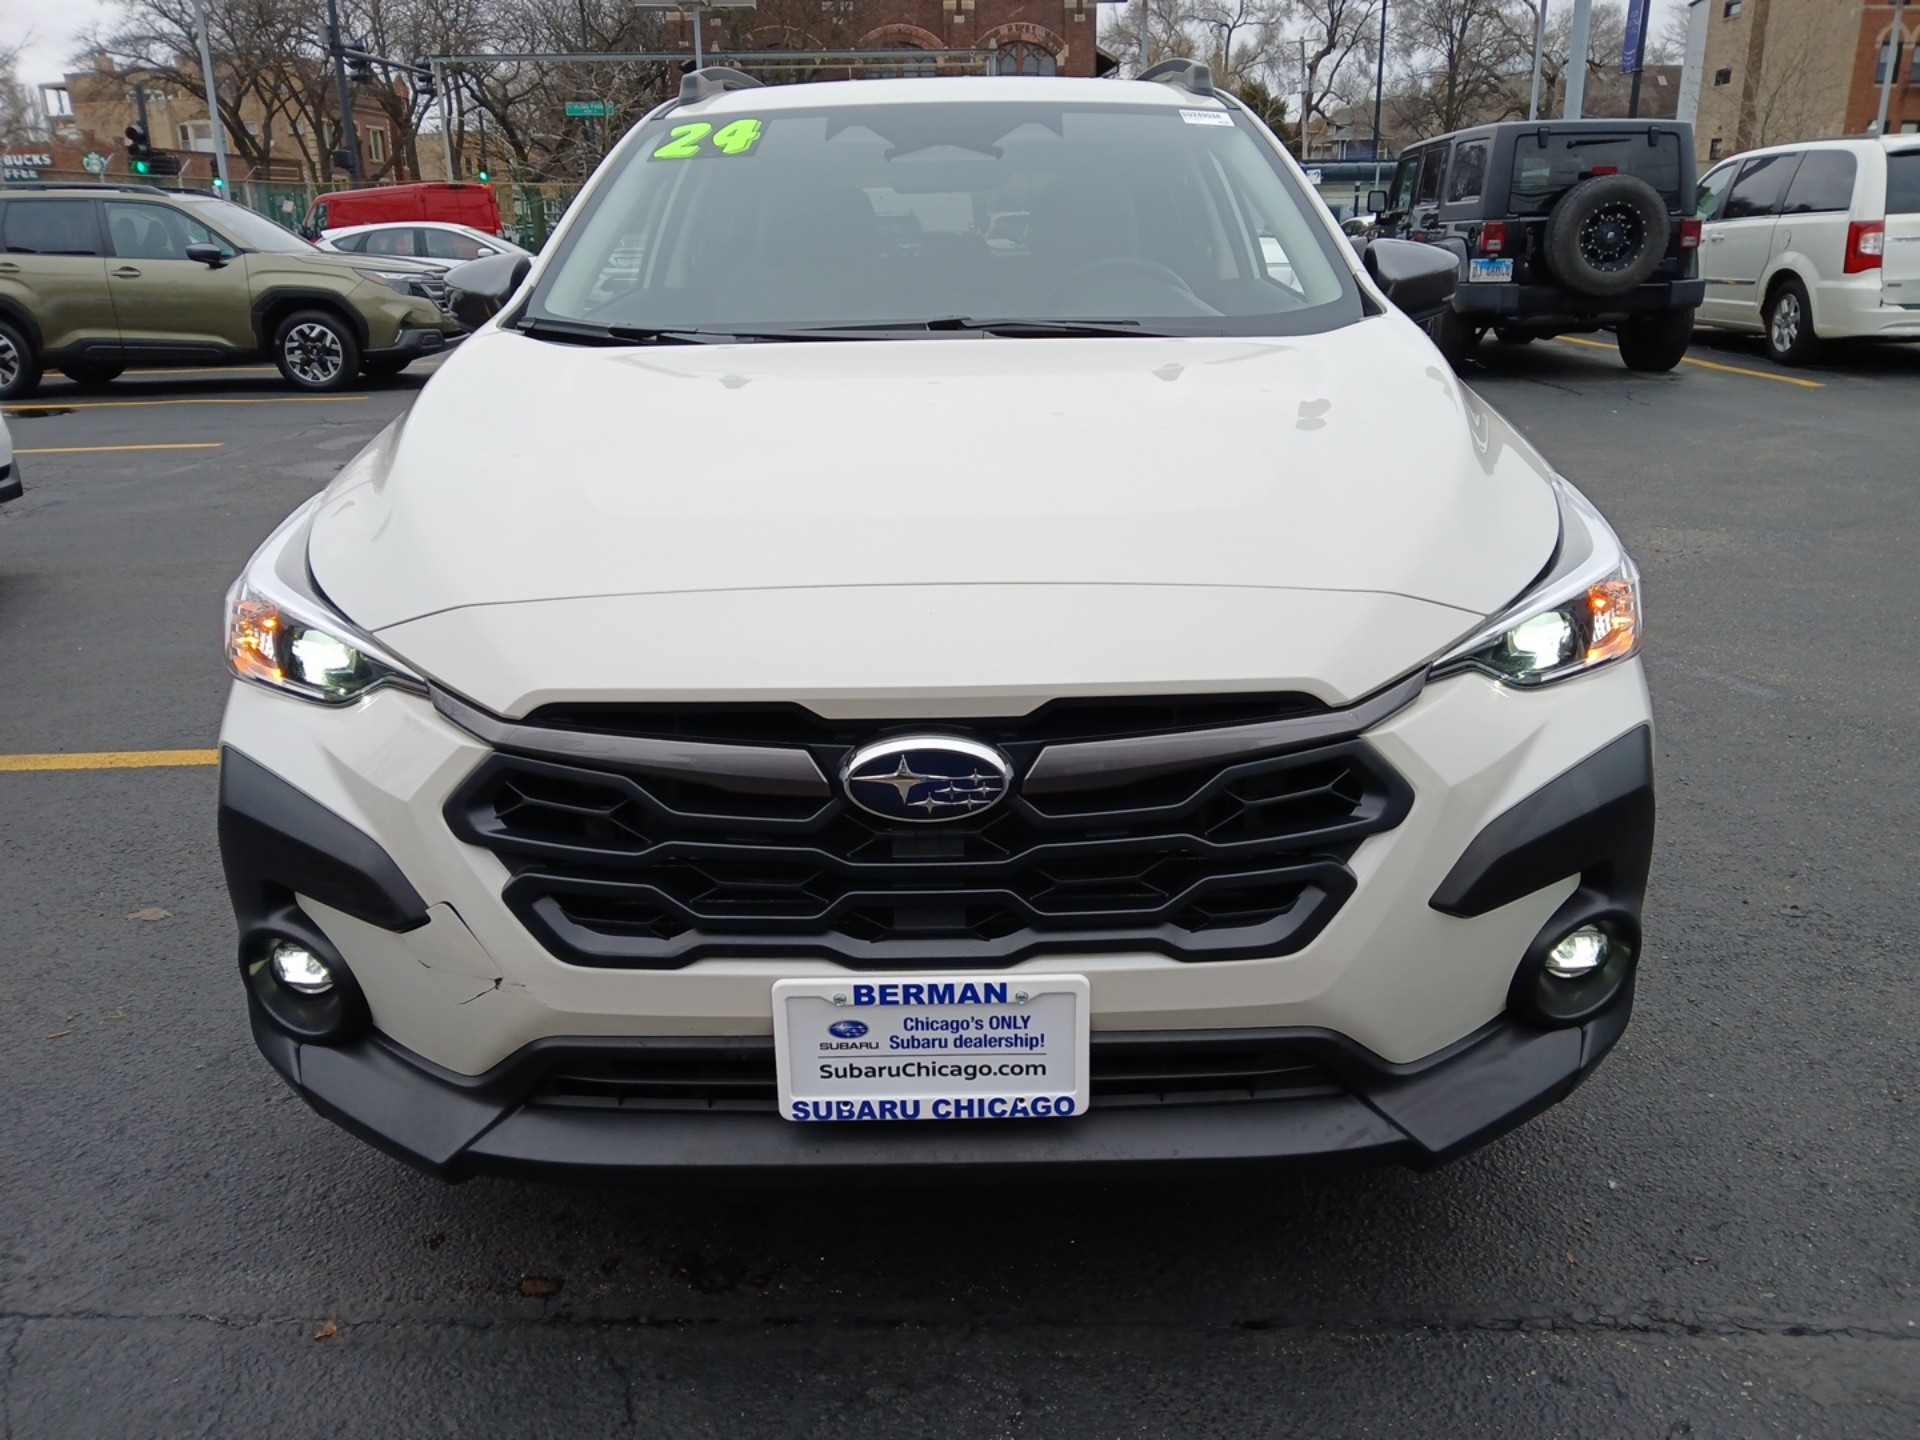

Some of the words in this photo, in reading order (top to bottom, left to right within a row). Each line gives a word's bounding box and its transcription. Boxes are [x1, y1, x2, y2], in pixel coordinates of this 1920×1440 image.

[653, 119, 762, 159] 24
[852, 982, 1008, 1006] BERMAN
[903, 1016, 984, 1033] Chicago's
[989, 1015, 1031, 1031] ONLY
[819, 1042, 879, 1050] SUBARU
[889, 1035, 948, 1050] Subaru
[953, 1033, 1045, 1051] dealership!
[819, 1061, 1047, 1081] SubaruChicago.com
[792, 1099, 921, 1121] SUBARU
[932, 1095, 1076, 1120] CHICAGO
